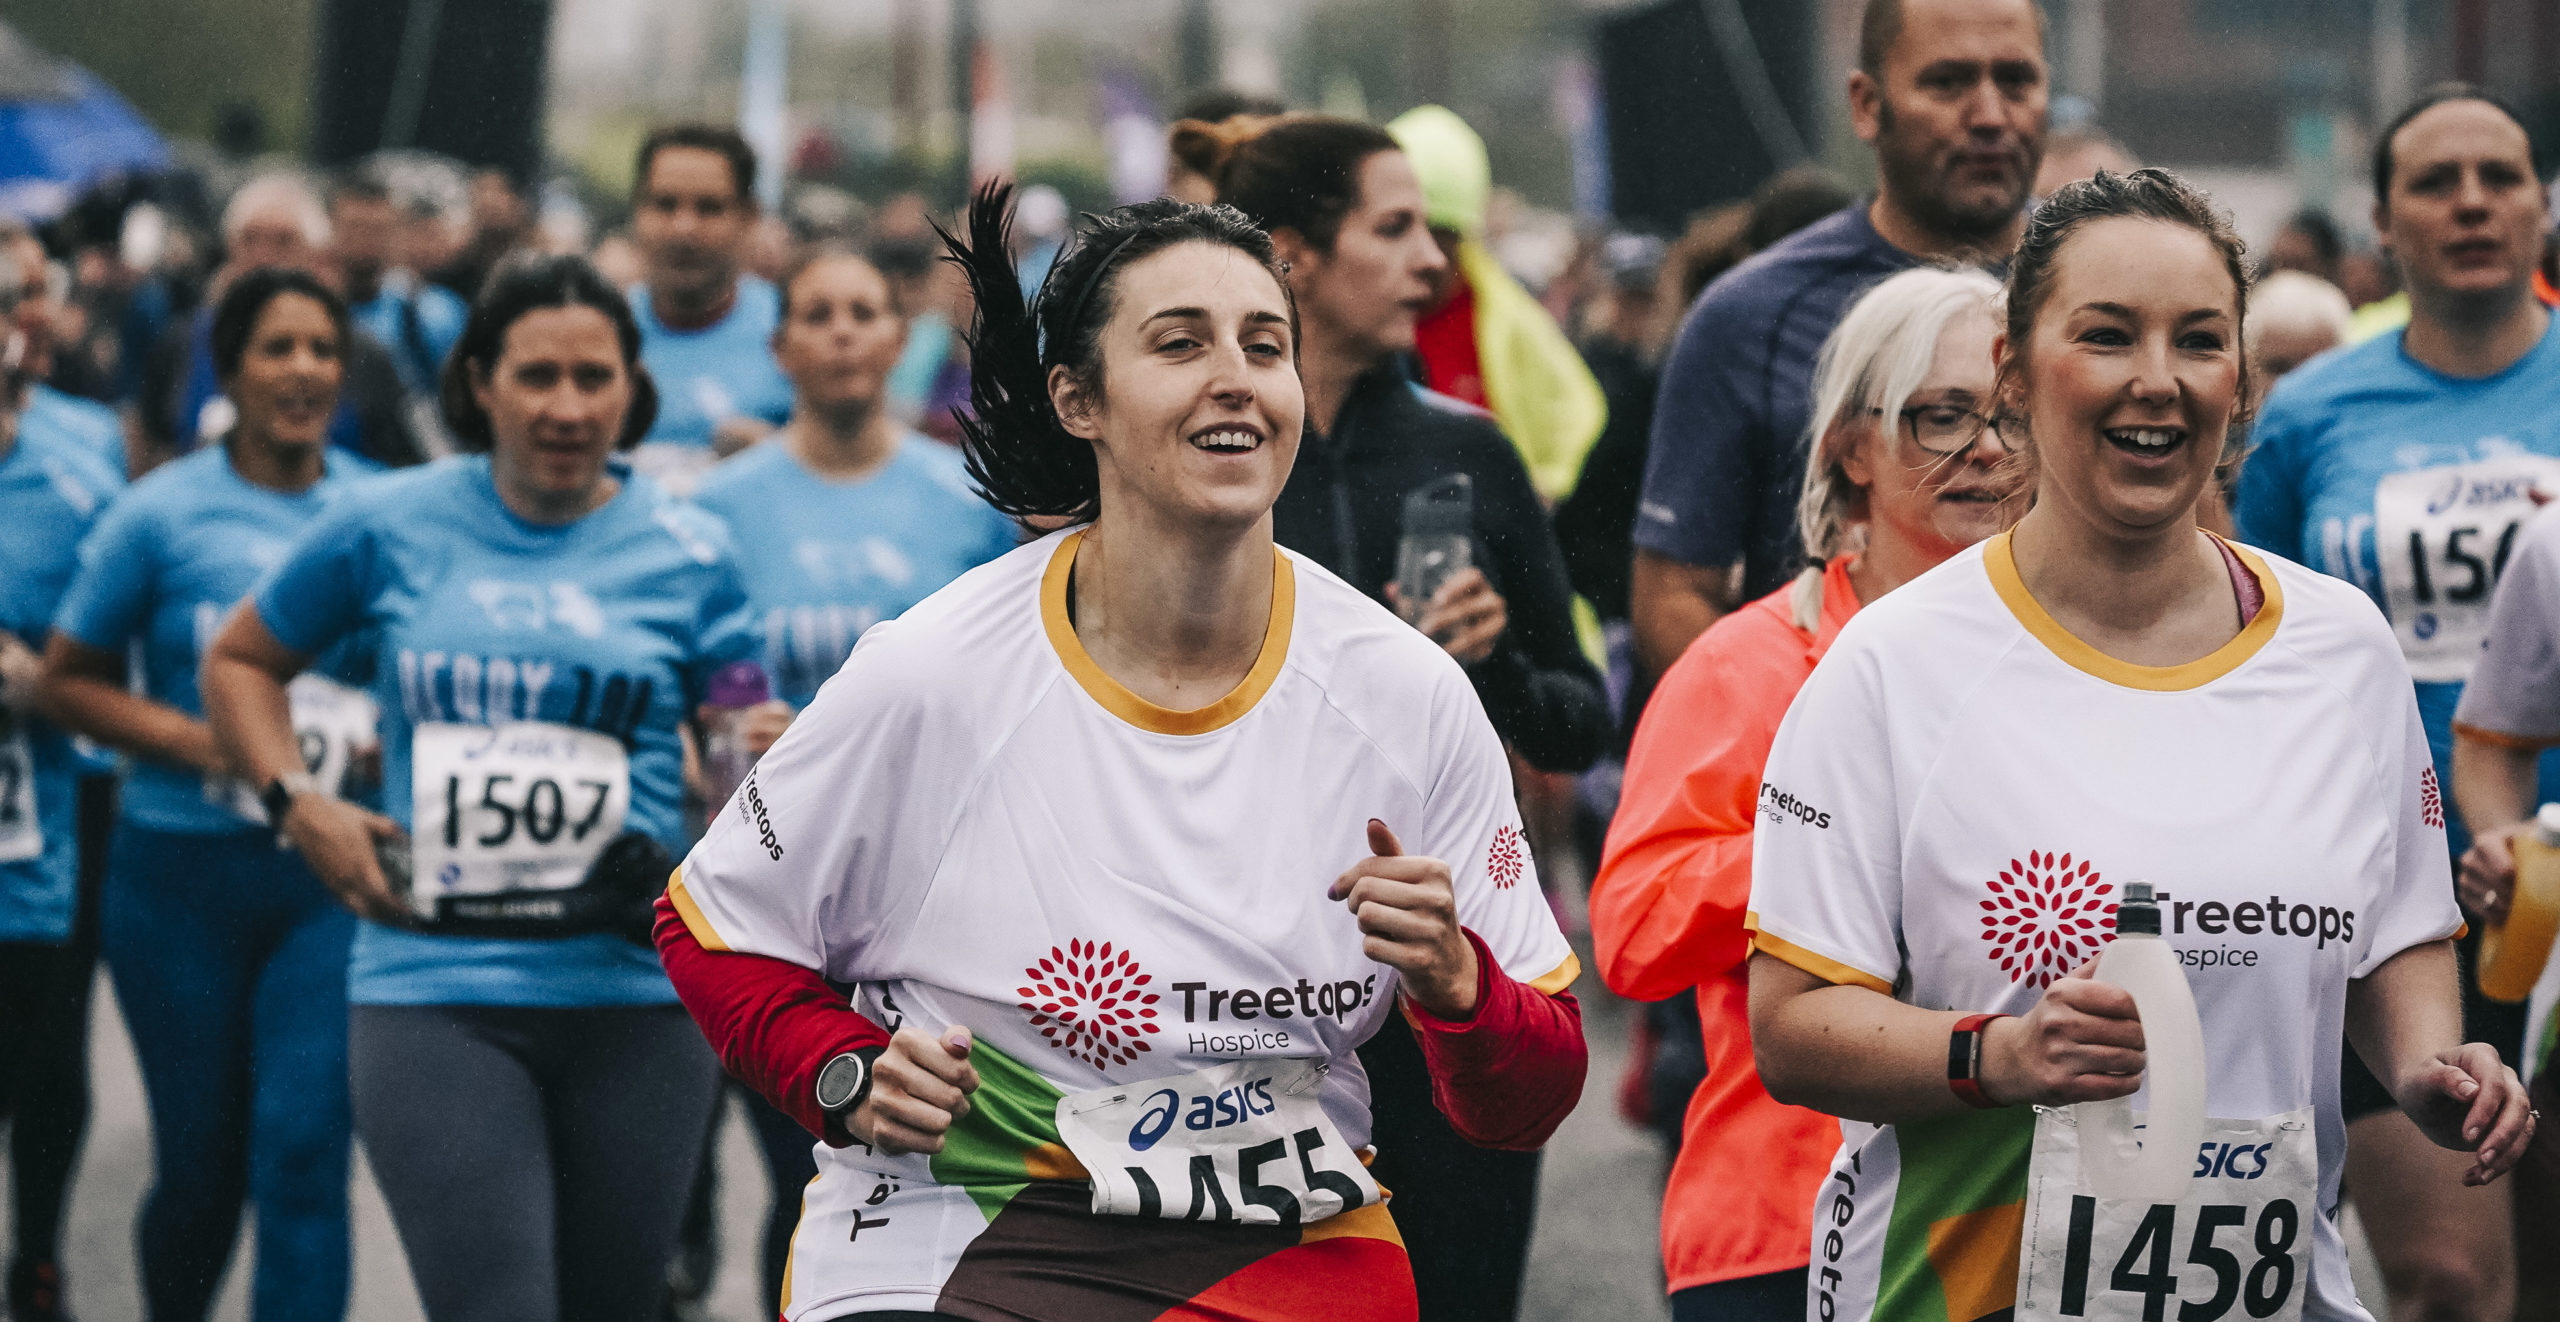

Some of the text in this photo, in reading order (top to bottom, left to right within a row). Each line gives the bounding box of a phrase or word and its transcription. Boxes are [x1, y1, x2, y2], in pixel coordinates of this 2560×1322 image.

[2409, 519, 2519, 605] 15
[445, 776, 610, 848] 1507
[1760, 781, 1832, 830] reetops
[1171, 973, 1376, 1025] Treetops
[1188, 1028, 1290, 1056] Hospice
[2059, 1195, 2299, 1322] 1458
